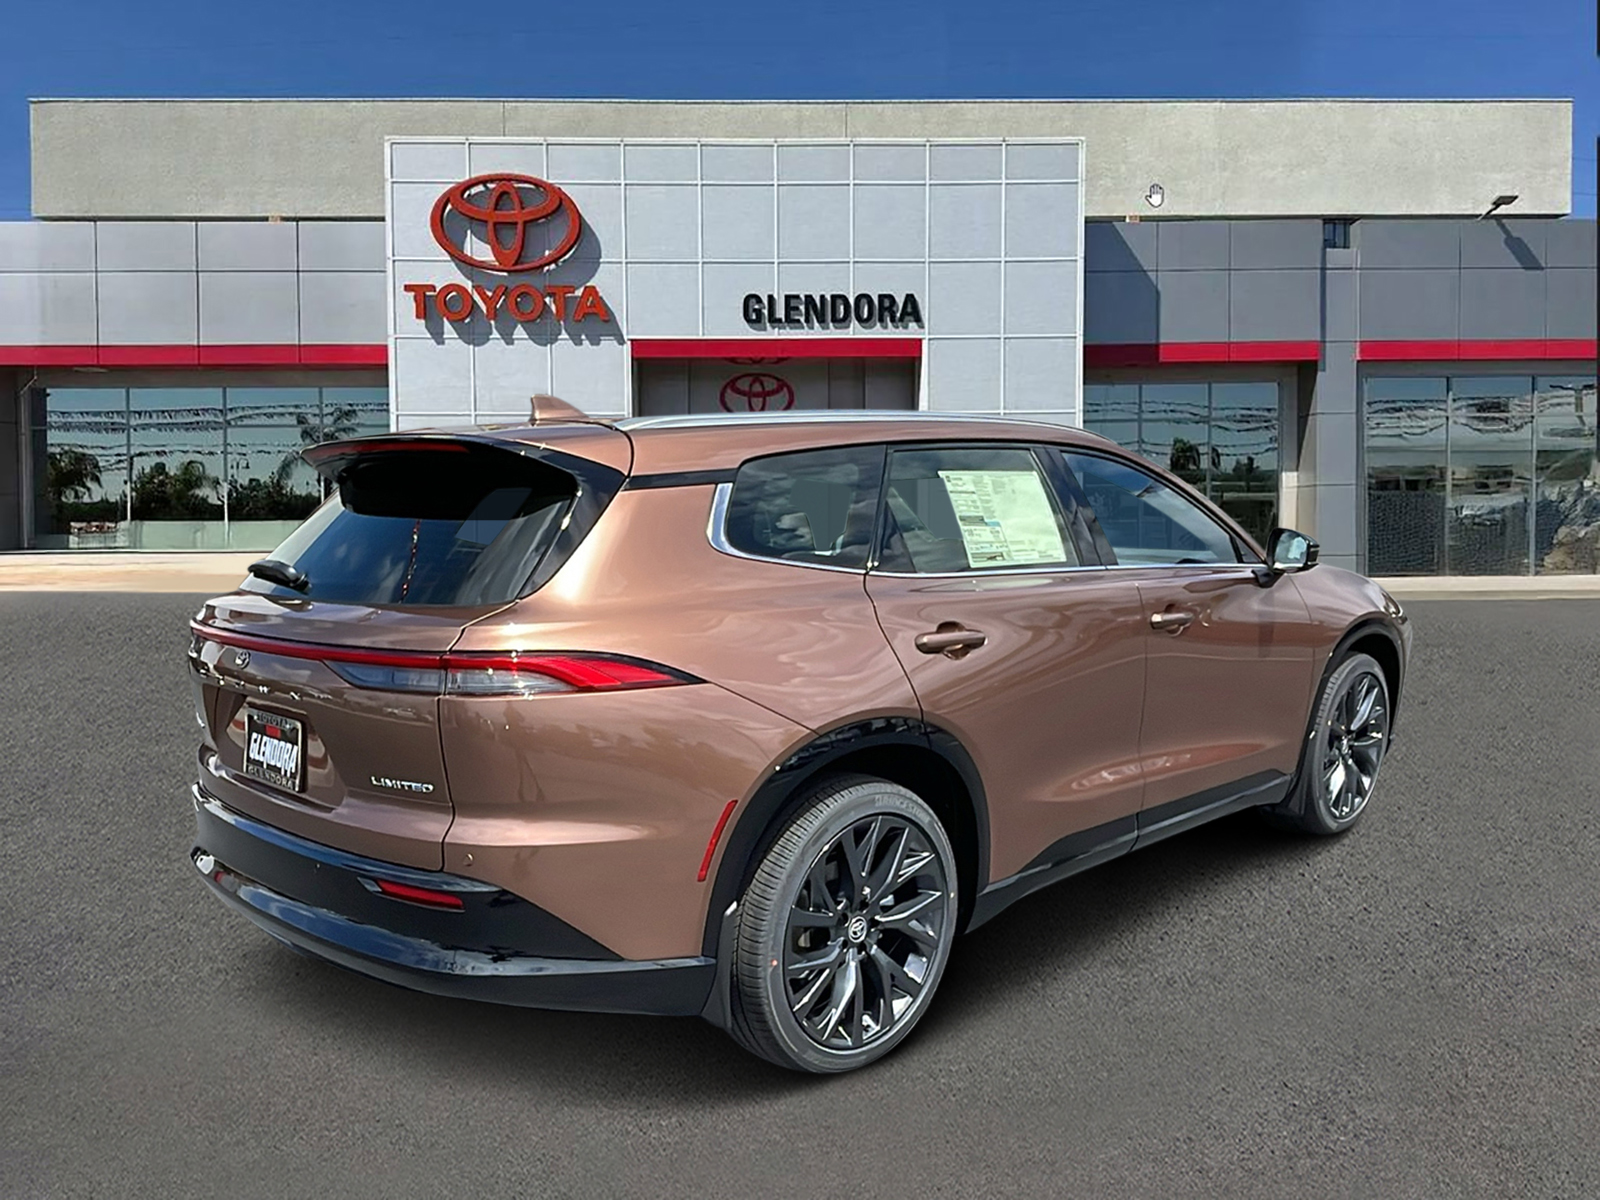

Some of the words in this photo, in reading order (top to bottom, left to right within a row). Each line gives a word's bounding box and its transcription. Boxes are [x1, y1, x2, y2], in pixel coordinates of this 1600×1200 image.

[404, 283, 610, 322] TOYOTA
[743, 293, 923, 325] GLENDORA
[249, 731, 299, 777] GLENDORA
[248, 764, 293, 790] GLENDORA
[370, 776, 434, 792] LIMITED
